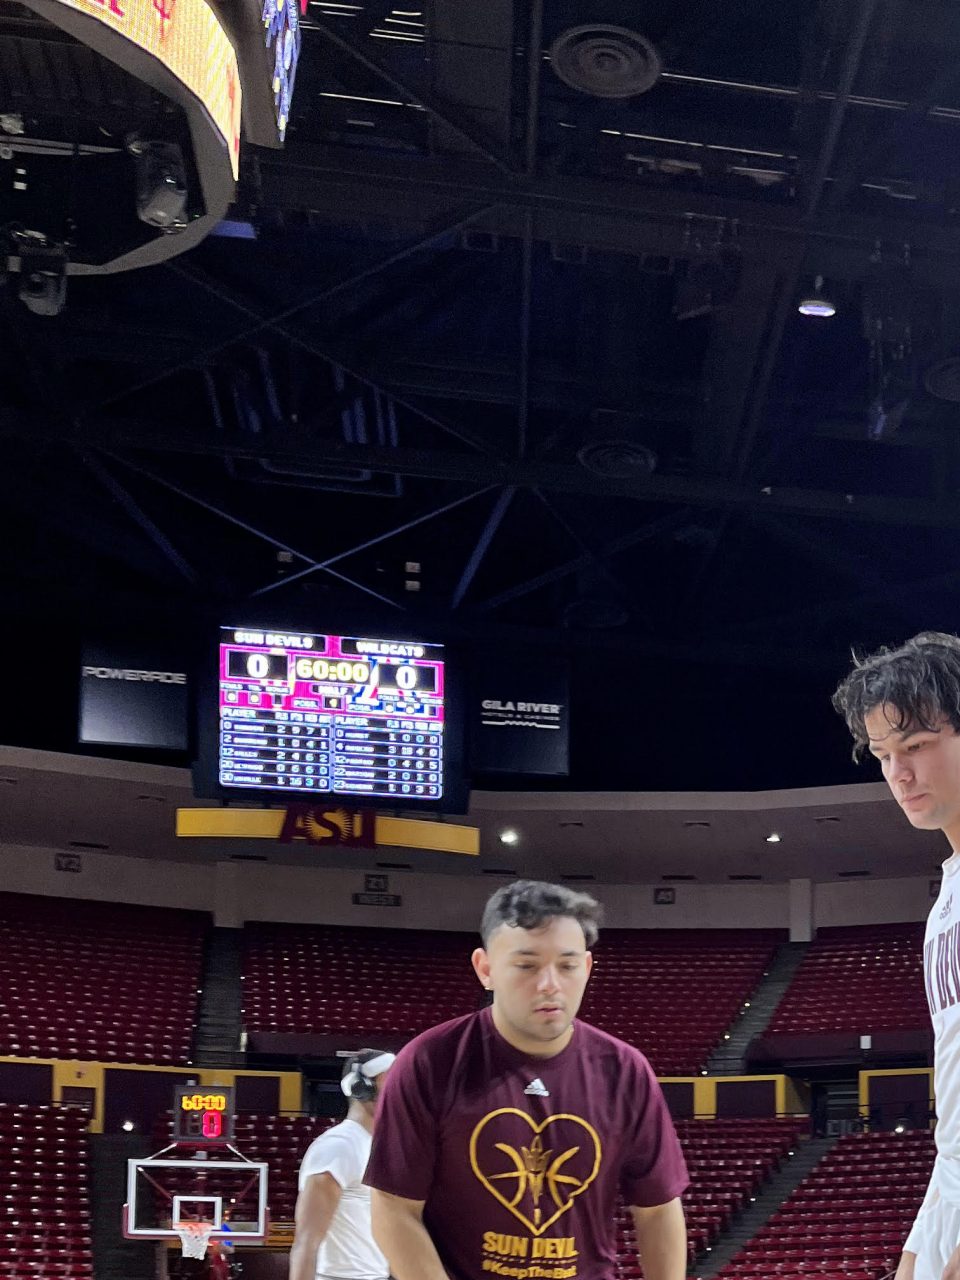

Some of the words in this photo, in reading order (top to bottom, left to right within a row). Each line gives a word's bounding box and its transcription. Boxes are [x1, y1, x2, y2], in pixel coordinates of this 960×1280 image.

[234, 632, 264, 644] SUN
[265, 634, 313, 649] DEVILS
[356, 641, 425, 657] WILDCATS
[247, 654, 269, 678] 0
[296, 659, 370, 682] 60:00
[396, 665, 417, 689] 0
[222, 707, 256, 718] PLAYER
[481, 700, 516, 711] GILA
[517, 702, 560, 714] RIVER
[335, 717, 369, 726] PLAYER
[277, 725, 286, 733] 2
[307, 727, 315, 735] 7
[320, 728, 328, 736] 1
[389, 733, 396, 741] 1
[223, 735, 232, 743] 2
[278, 738, 286, 746] 1
[320, 741, 328, 749] 1
[222, 748, 234, 756] 12
[277, 751, 286, 759] 2
[319, 754, 328, 762] 2
[388, 771, 396, 779] 2
[416, 785, 424, 793] 3
[429, 786, 437, 795] 3
[279, 803, 377, 849] ASU
[181, 1095, 226, 1111] 60:00
[202, 1110, 222, 1138] 0
[482, 1231, 528, 1257] SUN
[531, 1237, 579, 1258] DEVIL
